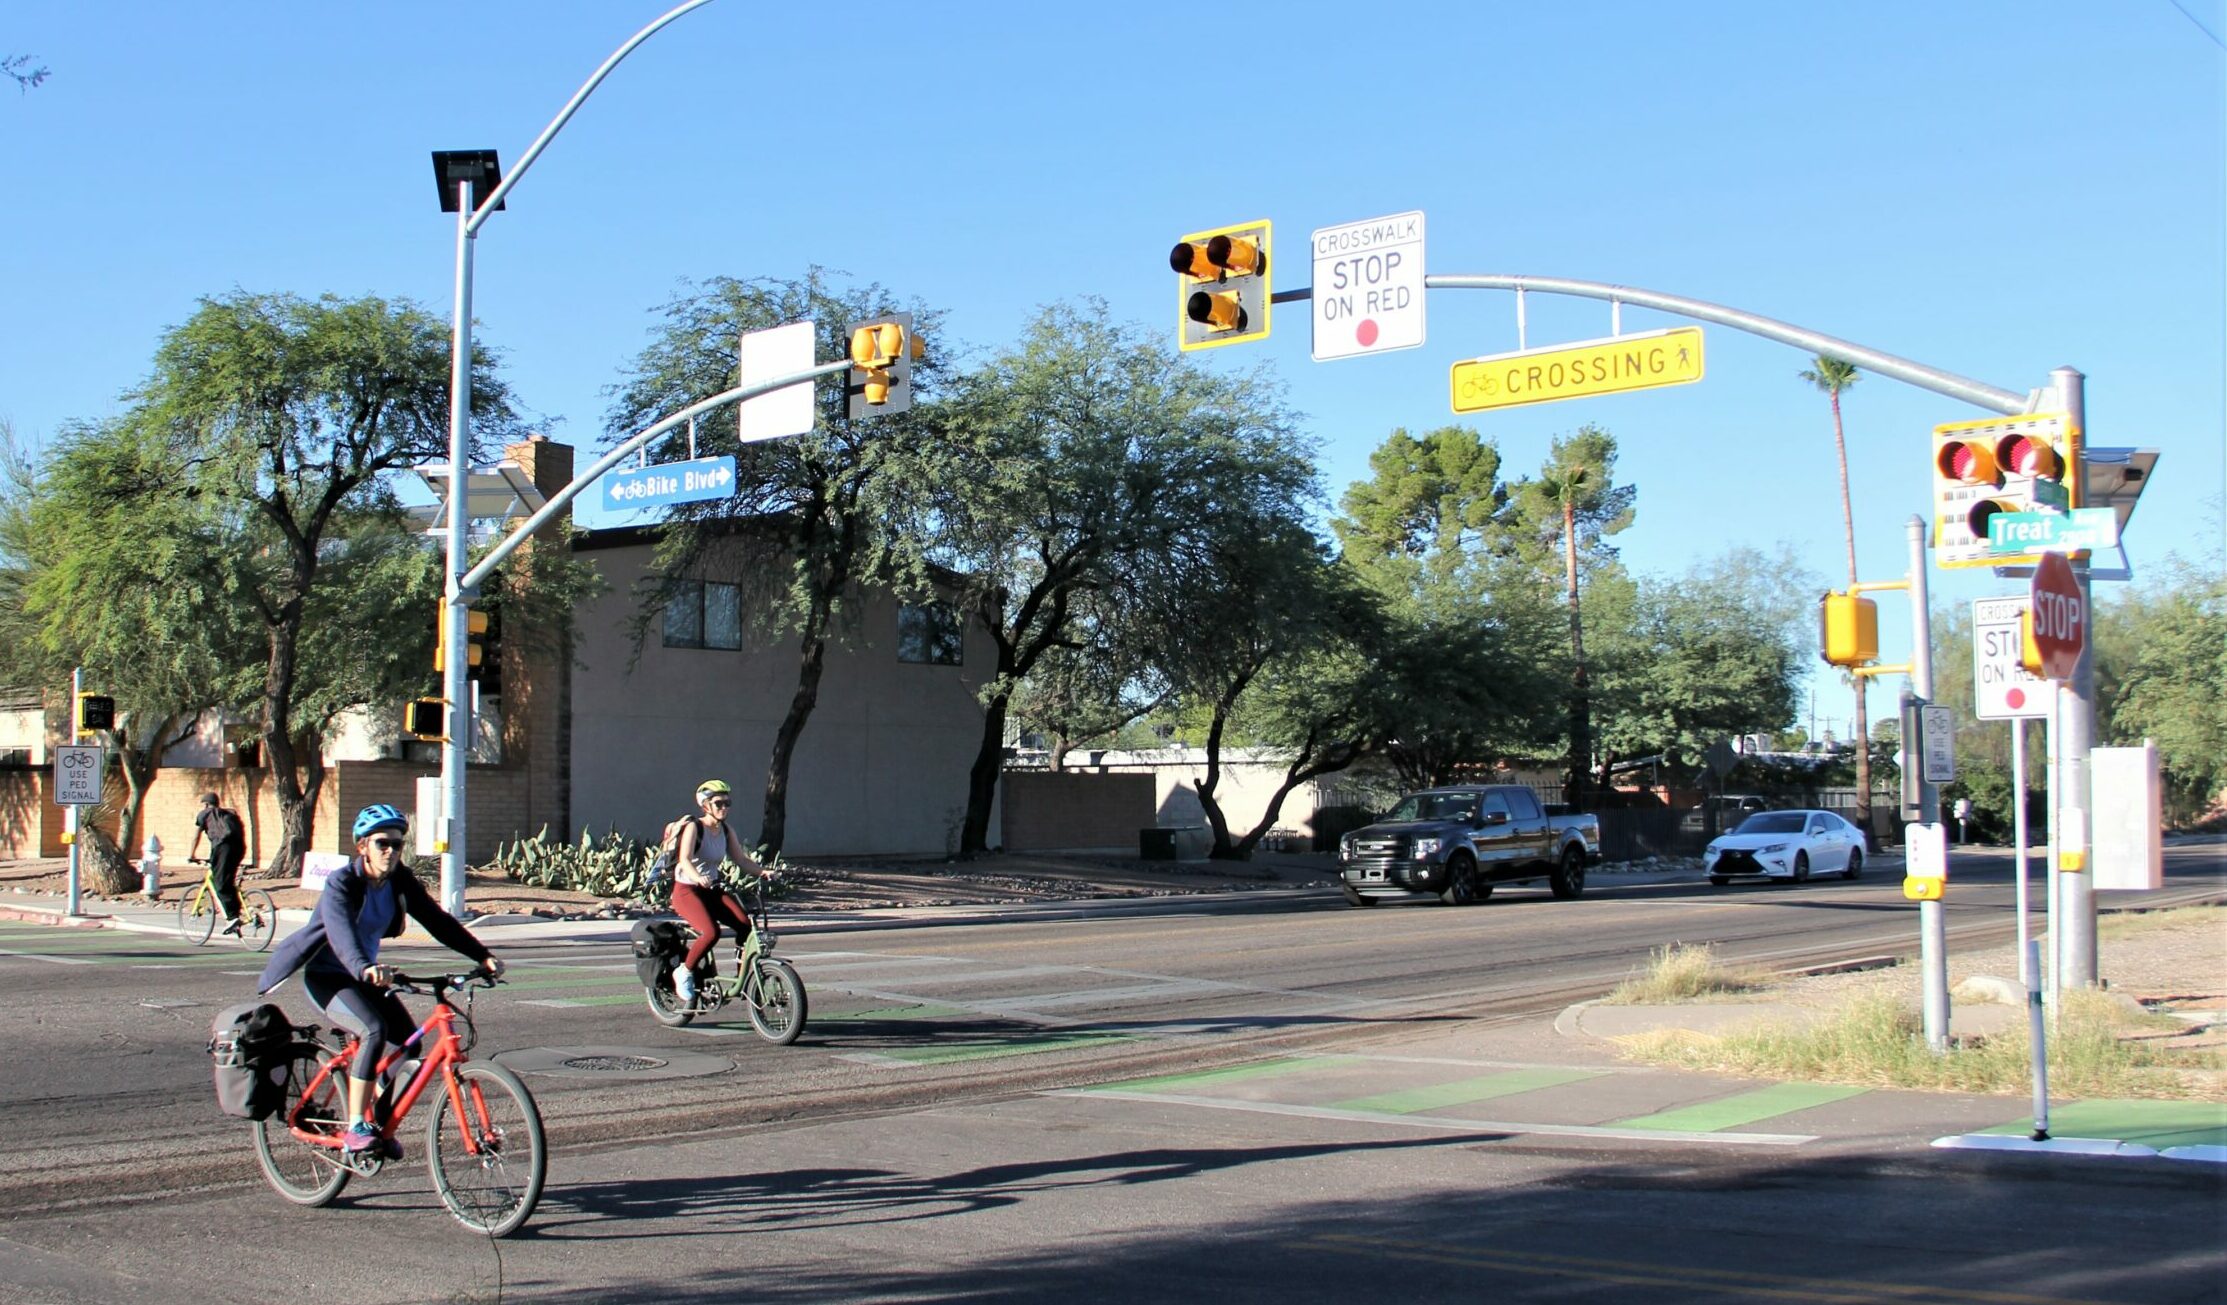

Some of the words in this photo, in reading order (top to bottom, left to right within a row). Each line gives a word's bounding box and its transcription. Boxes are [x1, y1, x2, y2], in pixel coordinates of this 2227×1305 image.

[1318, 219, 1416, 254] CROSSWALK
[1333, 252, 1402, 290] STOP
[1324, 294, 1353, 321] ON
[1367, 285, 1410, 314] RED
[1506, 347, 1665, 394] CROSSING
[647, 476, 678, 497] Bike
[685, 468, 716, 491] Blvd
[1992, 517, 2053, 546] Treat
[2034, 591, 2081, 642] STOP
[1985, 630, 2018, 658] ST
[1983, 664, 2004, 684] ON
[70, 770, 88, 779] USE
[70, 780, 87, 789] PED
[62, 791, 95, 800] SIGNAL
